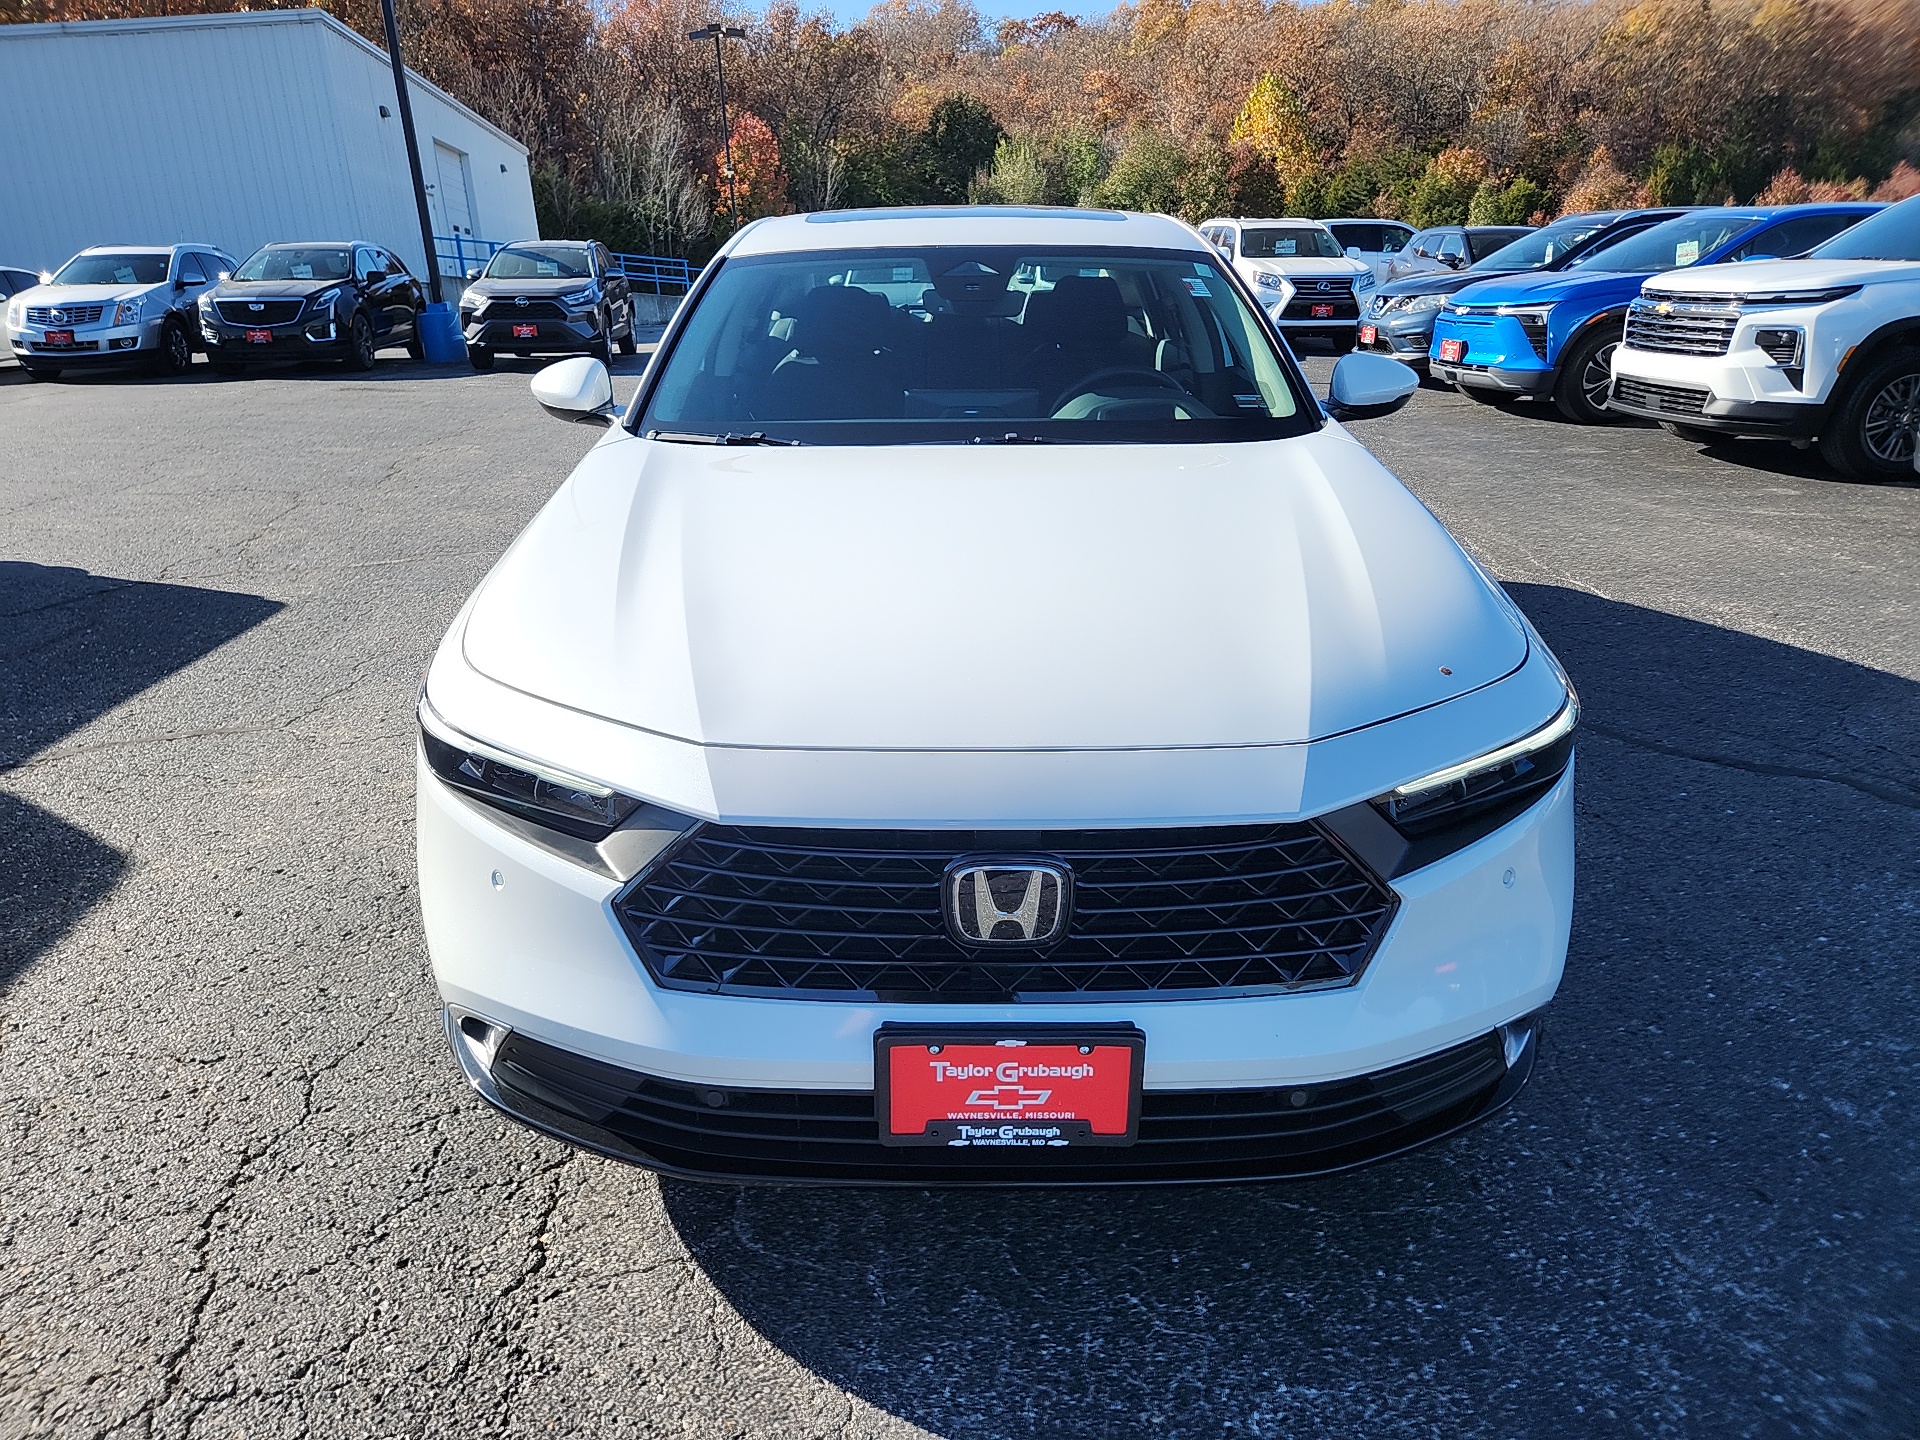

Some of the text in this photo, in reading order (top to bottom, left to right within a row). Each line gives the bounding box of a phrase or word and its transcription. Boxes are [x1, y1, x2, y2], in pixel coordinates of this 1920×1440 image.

[929, 1061, 1094, 1082] Taylor Grubaugh
[947, 1112, 1022, 1120] WAYNESVILLE,
[957, 1125, 1060, 1139] Taylor Grubaugh
